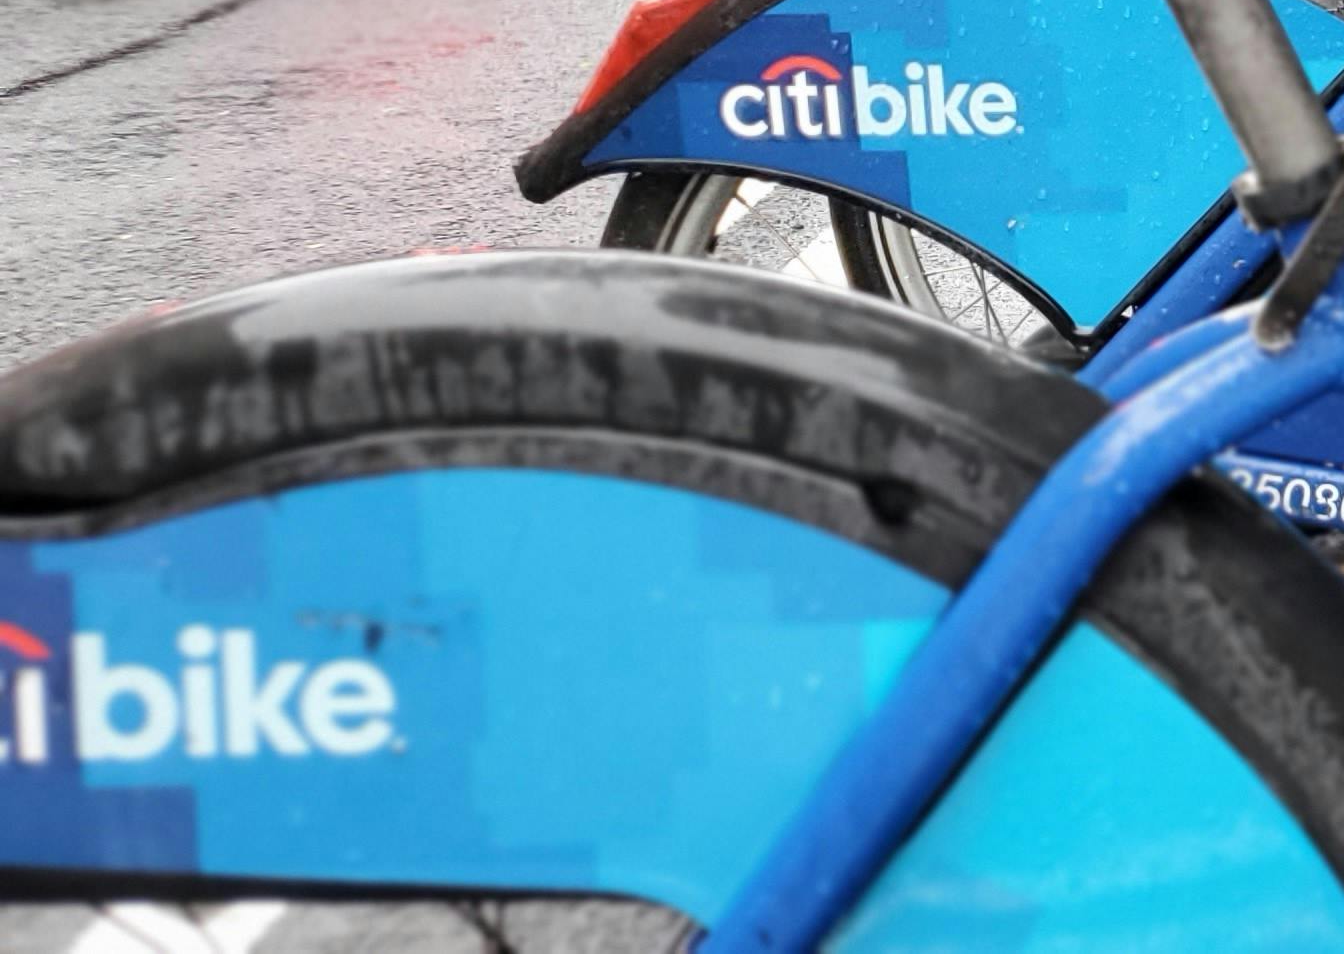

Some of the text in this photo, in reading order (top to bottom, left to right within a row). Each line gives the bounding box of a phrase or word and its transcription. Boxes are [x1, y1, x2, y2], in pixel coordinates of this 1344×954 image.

[720, 55, 1018, 138] citi bike
[0, 620, 396, 764] i bike
